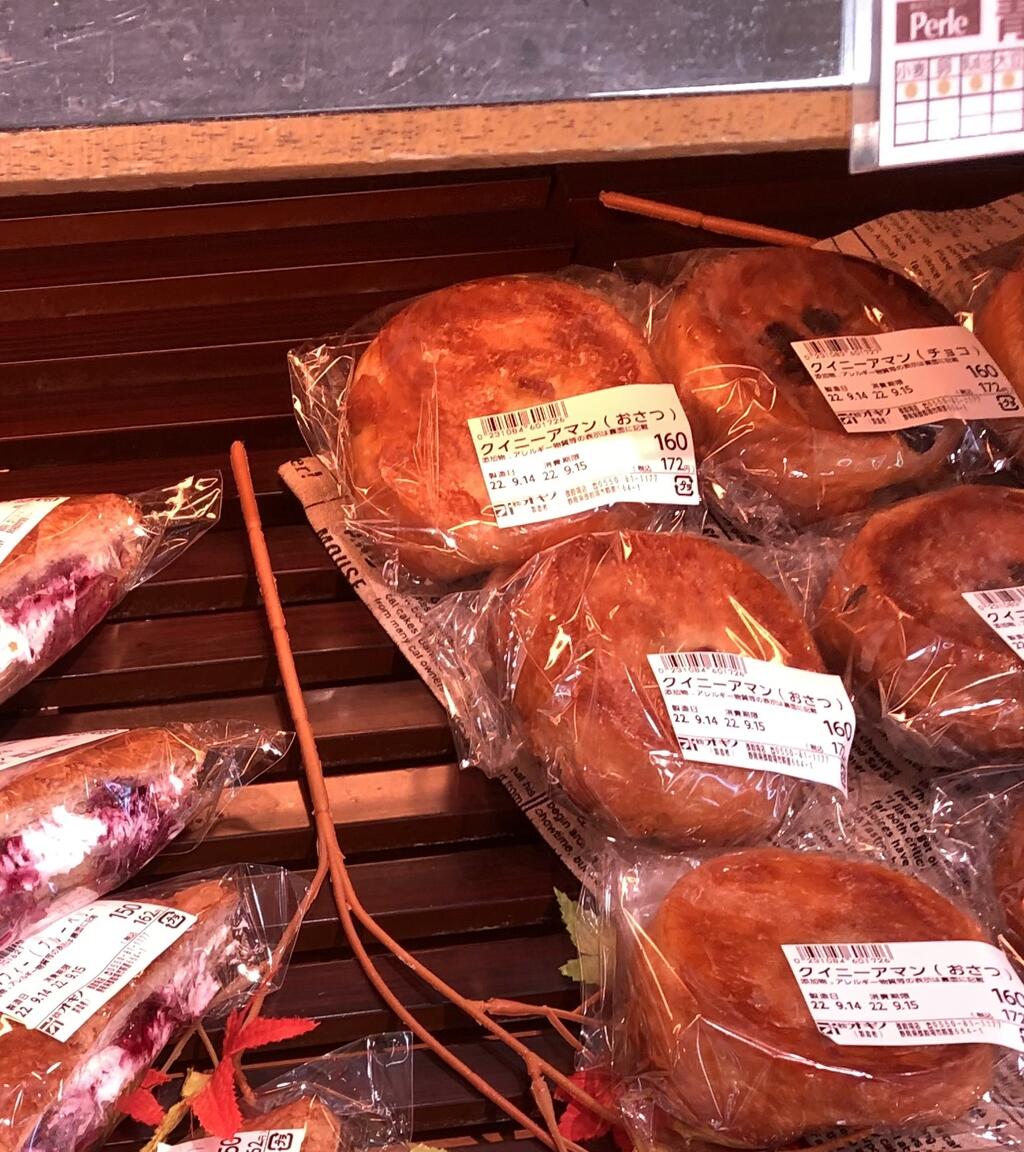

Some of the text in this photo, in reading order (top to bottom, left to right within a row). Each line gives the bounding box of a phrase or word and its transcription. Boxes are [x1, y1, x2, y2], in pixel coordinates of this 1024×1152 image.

[910, 7, 969, 40] Perle
[966, 364, 999, 378] 160
[847, 392, 868, 400] 9.14
[893, 387, 914, 397] 9.15
[480, 408, 677, 456] クイニーアマン（おさつ）
[654, 432, 688, 452] 160
[511, 475, 536, 487] 9.14
[564, 461, 588, 476] 9.15
[374, 597, 391, 619] from
[390, 618, 410, 644] many
[395, 607, 419, 635] cakes
[662, 676, 844, 711] クイニーアマン（おさつ）
[696, 715, 719, 725] 9.14
[744, 720, 766, 732] 9.15
[824, 720, 853, 742] 160
[547, 801, 571, 829] begin
[888, 812, 907, 835] both
[892, 802, 920, 833] like to
[892, 839, 909, 867] have
[109, 904, 143, 920] 150
[30, 989, 52, 1005] 9.14
[70, 966, 87, 981] 9.15
[798, 964, 1013, 981] クイニーアマン（おさつ）
[836, 1001, 862, 1010] 9.14
[893, 1000, 919, 1011] 9.15
